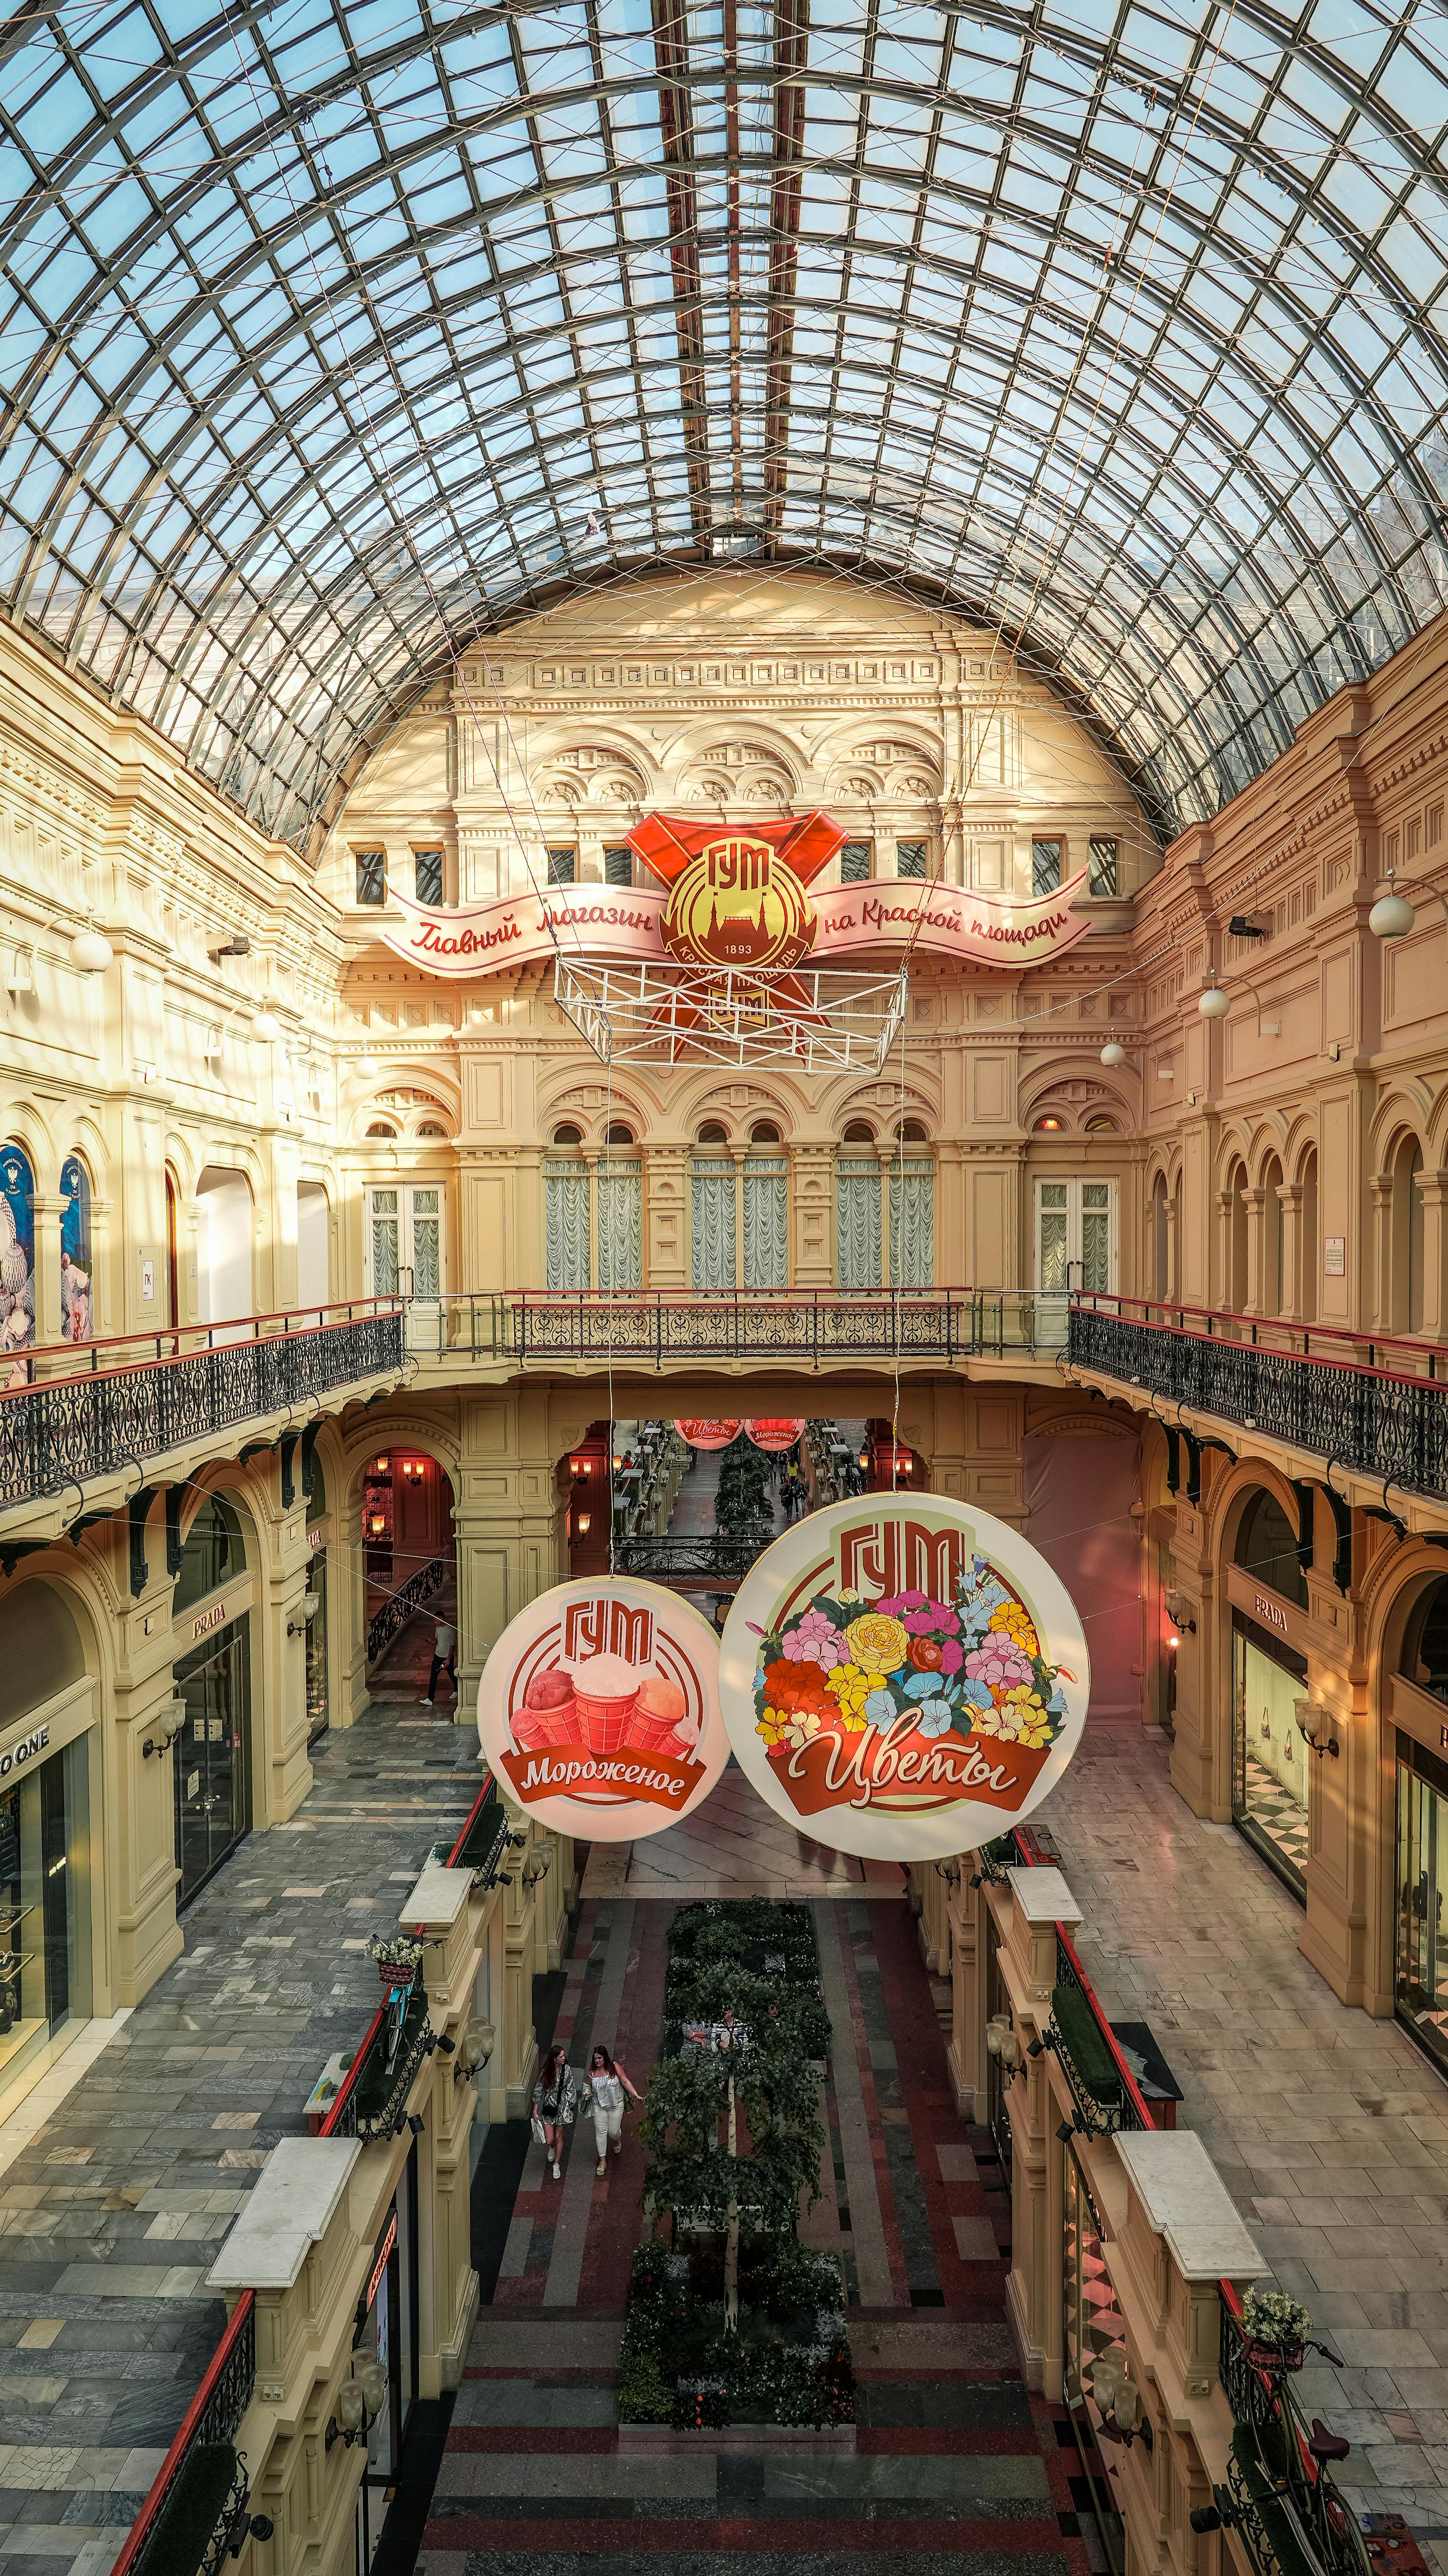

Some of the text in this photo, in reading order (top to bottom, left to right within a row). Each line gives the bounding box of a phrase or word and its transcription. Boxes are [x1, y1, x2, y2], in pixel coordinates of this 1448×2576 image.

[709, 843, 769, 890] ГУМ
[410, 904, 654, 955] Главный магазин
[825, 898, 1068, 948] на Красной площади
[724, 945, 751, 954] 1893
[145, 1274, 151, 1285] ПК
[685, 1419, 732, 1439] Цветы
[755, 1431, 795, 1440] Мороженое
[841, 1520, 965, 1610] ГУМ
[192, 1604, 225, 1640] PRADA
[1255, 1594, 1288, 1632] PRADA
[565, 1600, 653, 1666] ГУМ
[13, 1725, 50, 1765] ONE
[788, 1707, 1017, 1808] Цветы
[520, 1757, 685, 1796] Мороженое
